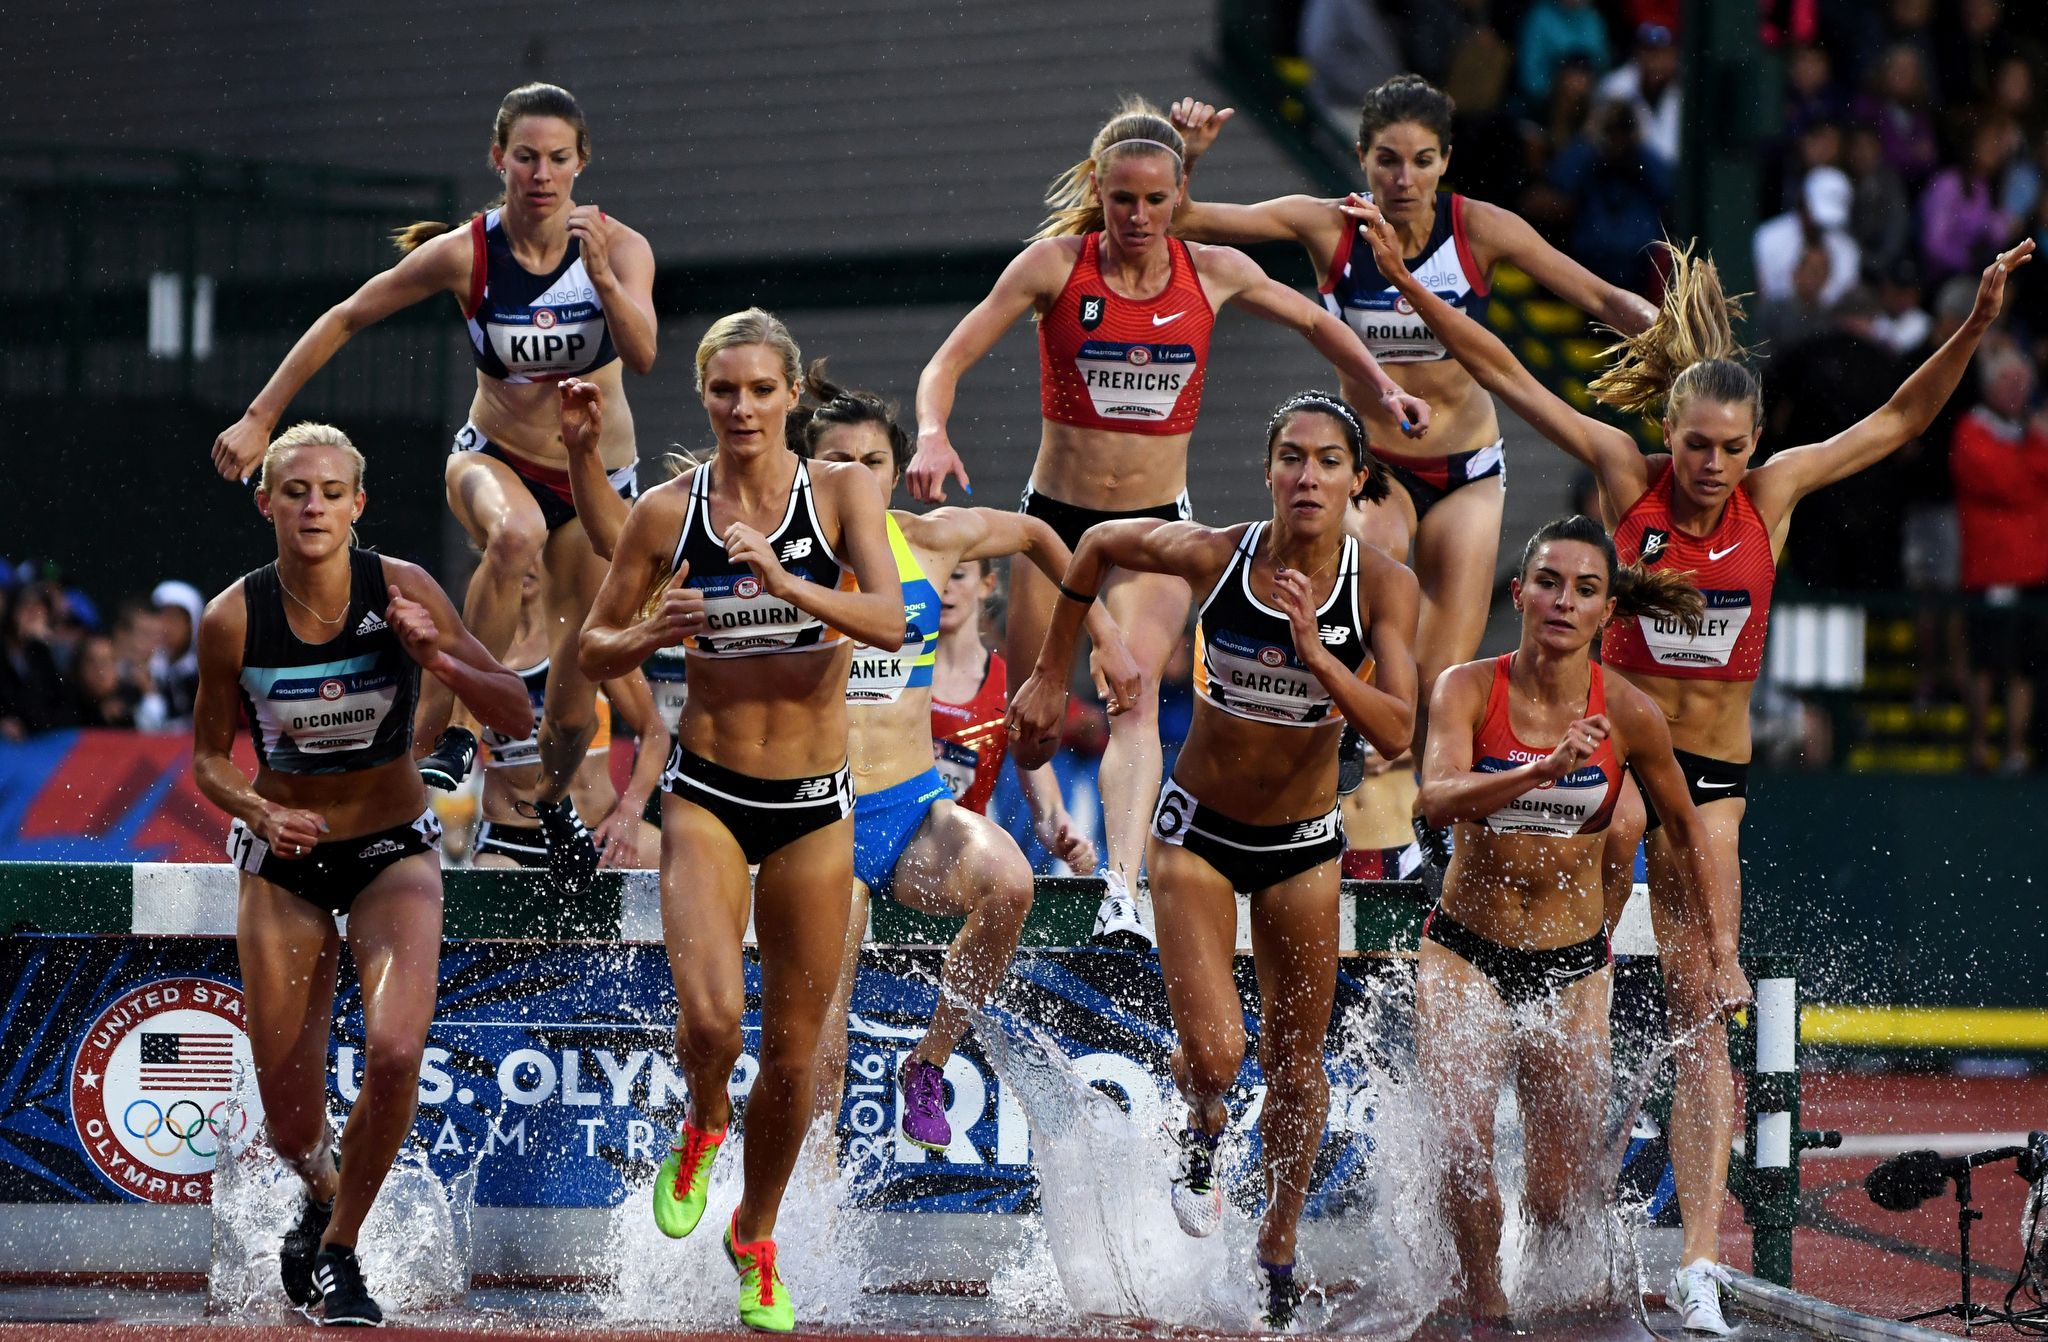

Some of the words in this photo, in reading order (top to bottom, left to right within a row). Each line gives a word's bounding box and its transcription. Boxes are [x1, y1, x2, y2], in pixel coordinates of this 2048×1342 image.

[1419, 271, 1457, 288] selle
[510, 333, 586, 363] KIPP
[1087, 370, 1181, 391] FRERICHS
[356, 620, 389, 636] adidas
[707, 607, 798, 630] COBURN
[1231, 670, 1309, 698] GARCIA
[293, 708, 376, 729] O'CONNOR
[1577, 773, 1600, 782] USATF
[1156, 790, 1189, 837] 6
[1504, 799, 1586, 816] GGINSON
[234, 827, 254, 870] 11
[358, 841, 405, 858] adidas
[93, 987, 180, 1050] UNITED
[193, 987, 244, 1018] STA
[337, 1047, 474, 1105] US.
[849, 1054, 886, 1162] 2016
[87, 1119, 202, 1197] OLYMPIC
